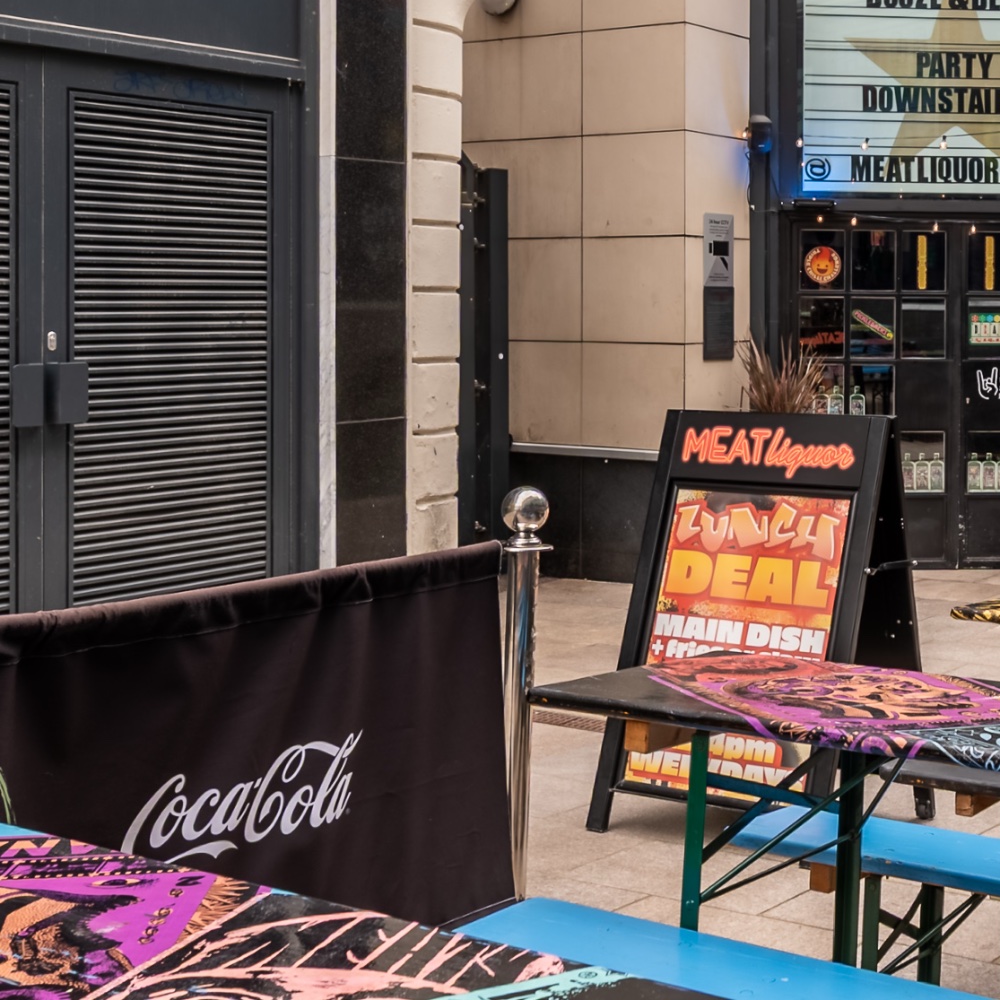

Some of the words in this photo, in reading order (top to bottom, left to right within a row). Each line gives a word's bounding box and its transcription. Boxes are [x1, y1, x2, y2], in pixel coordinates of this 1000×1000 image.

[916, 51, 993, 79] PARTY
[676, 502, 840, 560] LUNCH
[665, 549, 829, 609] DEAL
[653, 613, 744, 645] MAIN
[746, 623, 826, 654] DISH
